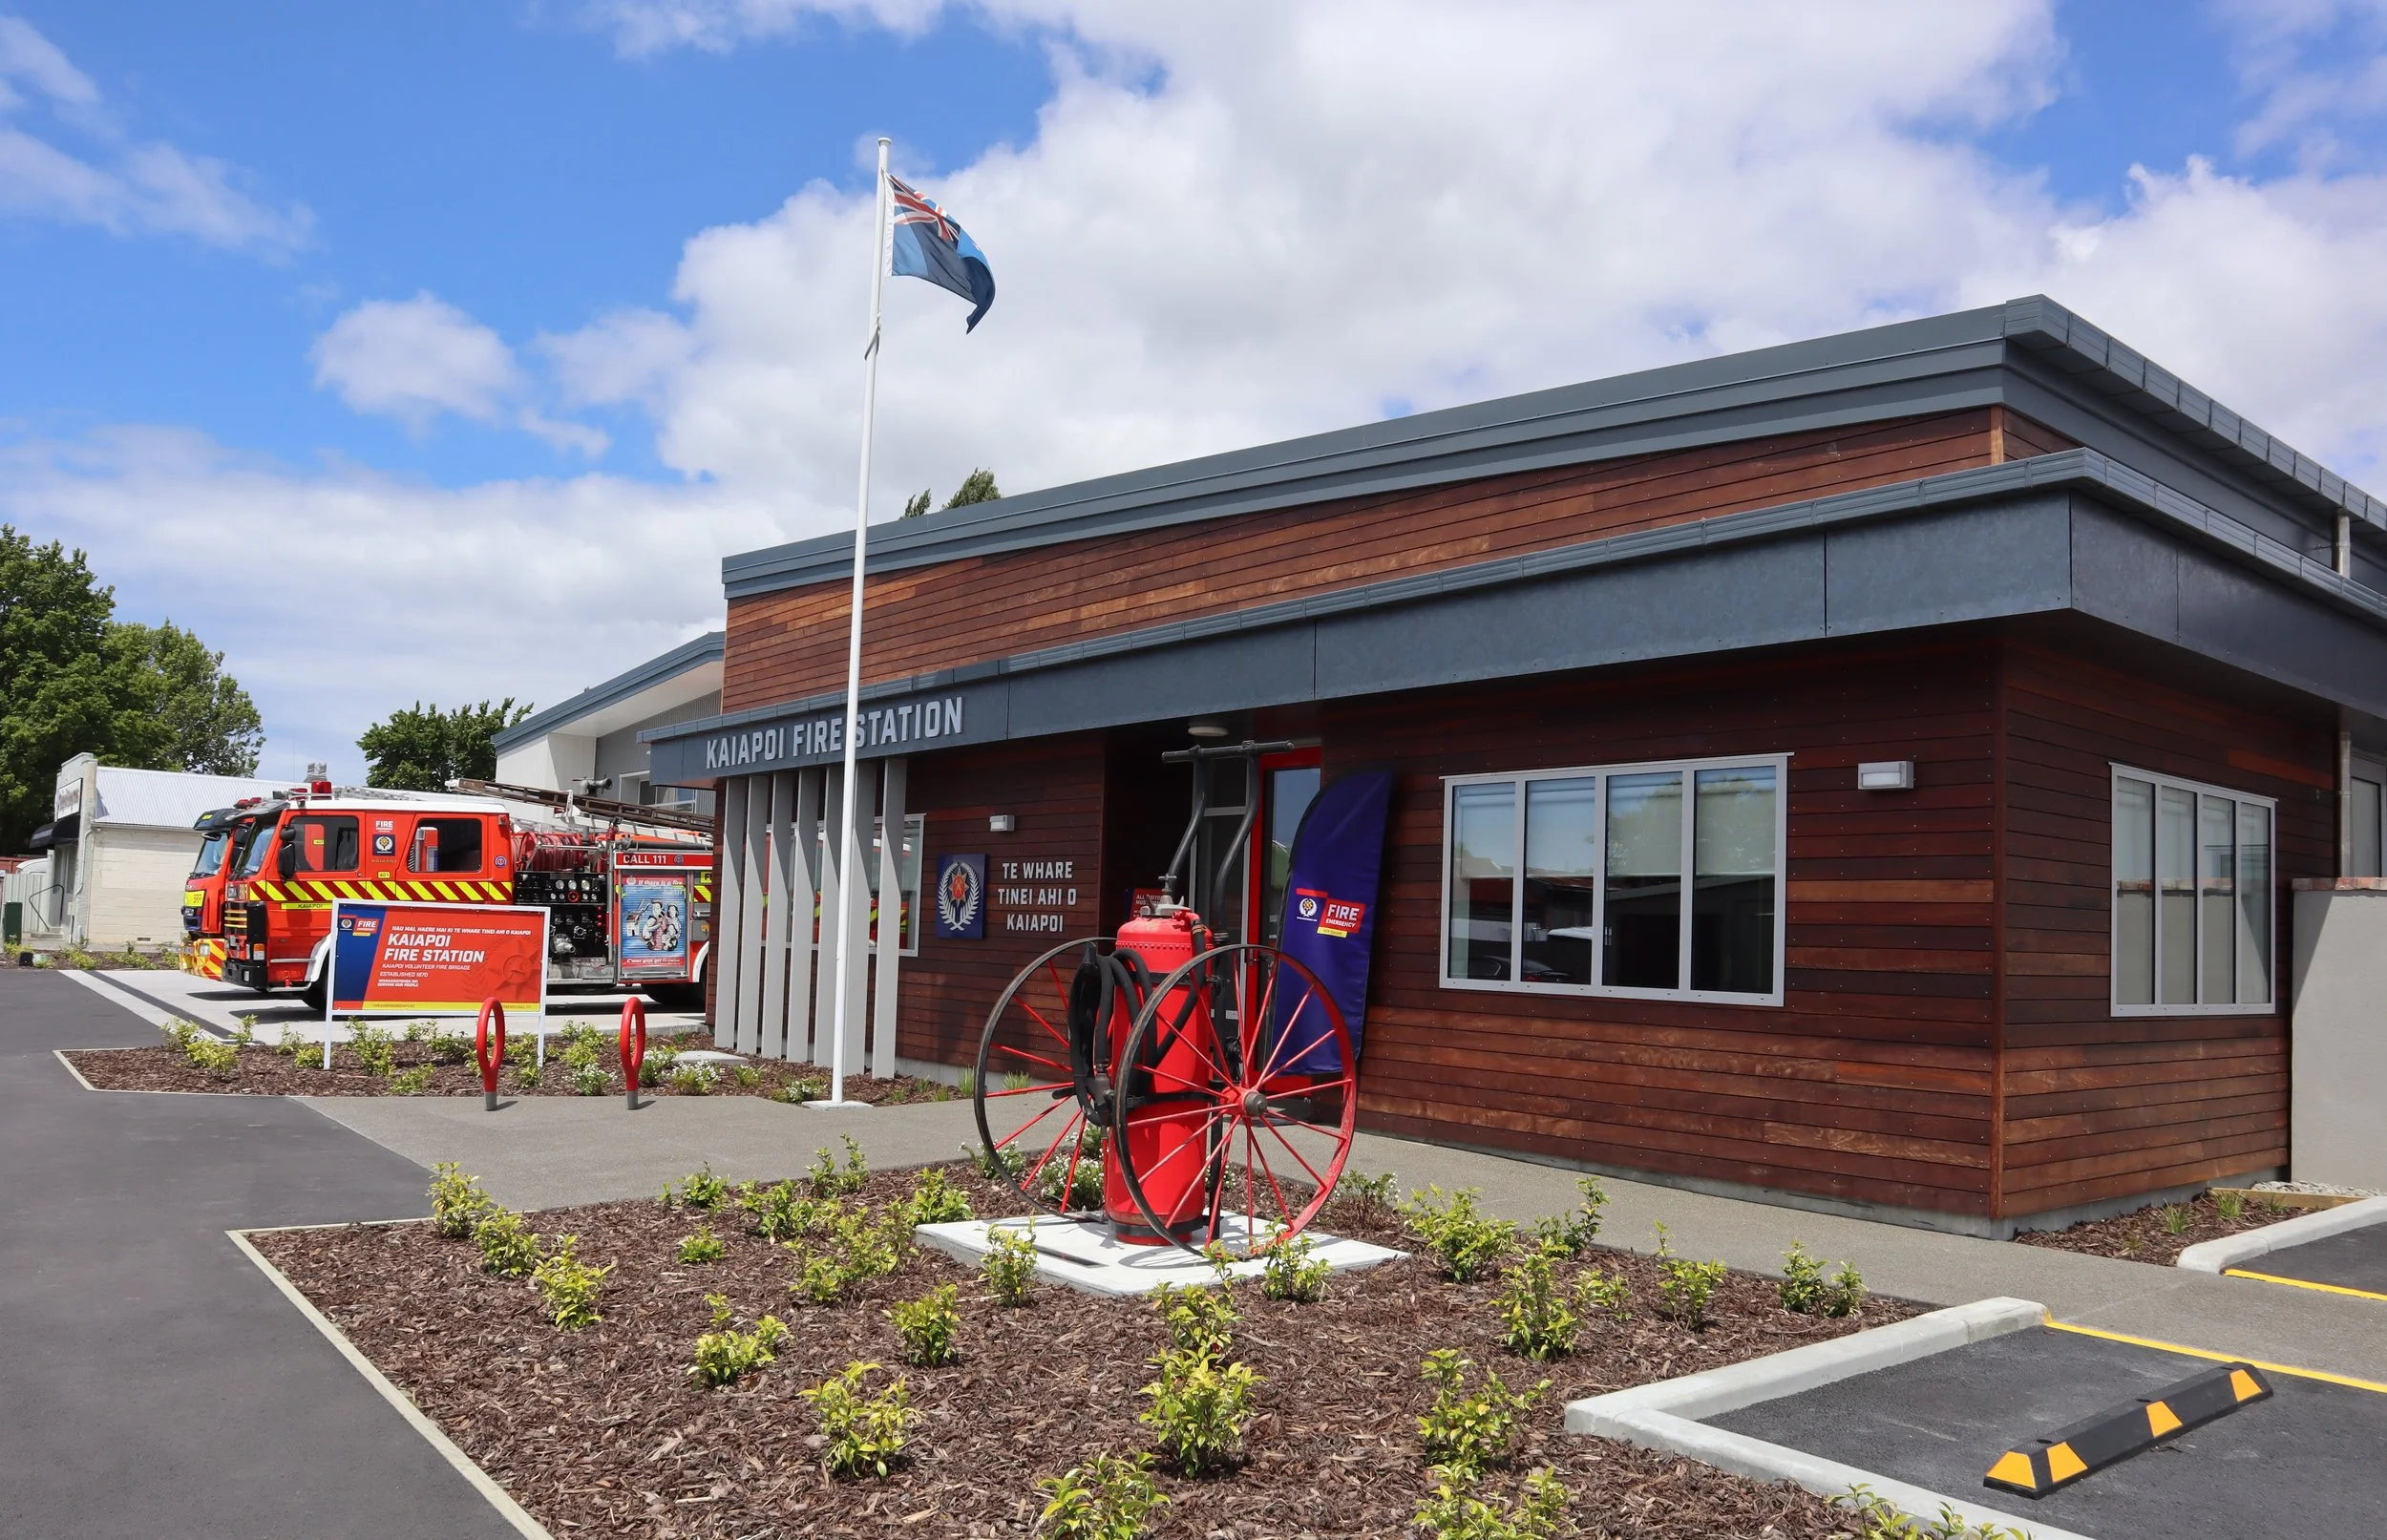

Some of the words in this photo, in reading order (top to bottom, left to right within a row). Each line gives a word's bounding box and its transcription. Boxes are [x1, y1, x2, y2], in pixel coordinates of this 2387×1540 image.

[706, 728, 785, 769] KAIAPOI
[792, 717, 843, 757] FIRE
[855, 697, 963, 748] STATION
[623, 854, 650, 864] CALL
[652, 854, 666, 864] 111
[1003, 862, 1018, 879] TE
[1023, 861, 1073, 879] WHARE
[998, 888, 1032, 905] TINEI
[1037, 888, 1062, 905] AHI
[1067, 888, 1077, 906] O
[1327, 903, 1360, 921] FIRE
[1006, 914, 1064, 932] KAIAPOI
[1325, 918, 1357, 928] EMERGENCY
[388, 933, 451, 947] KAIAPOI
[384, 947, 420, 961] FIRE
[422, 949, 485, 963] STATION
